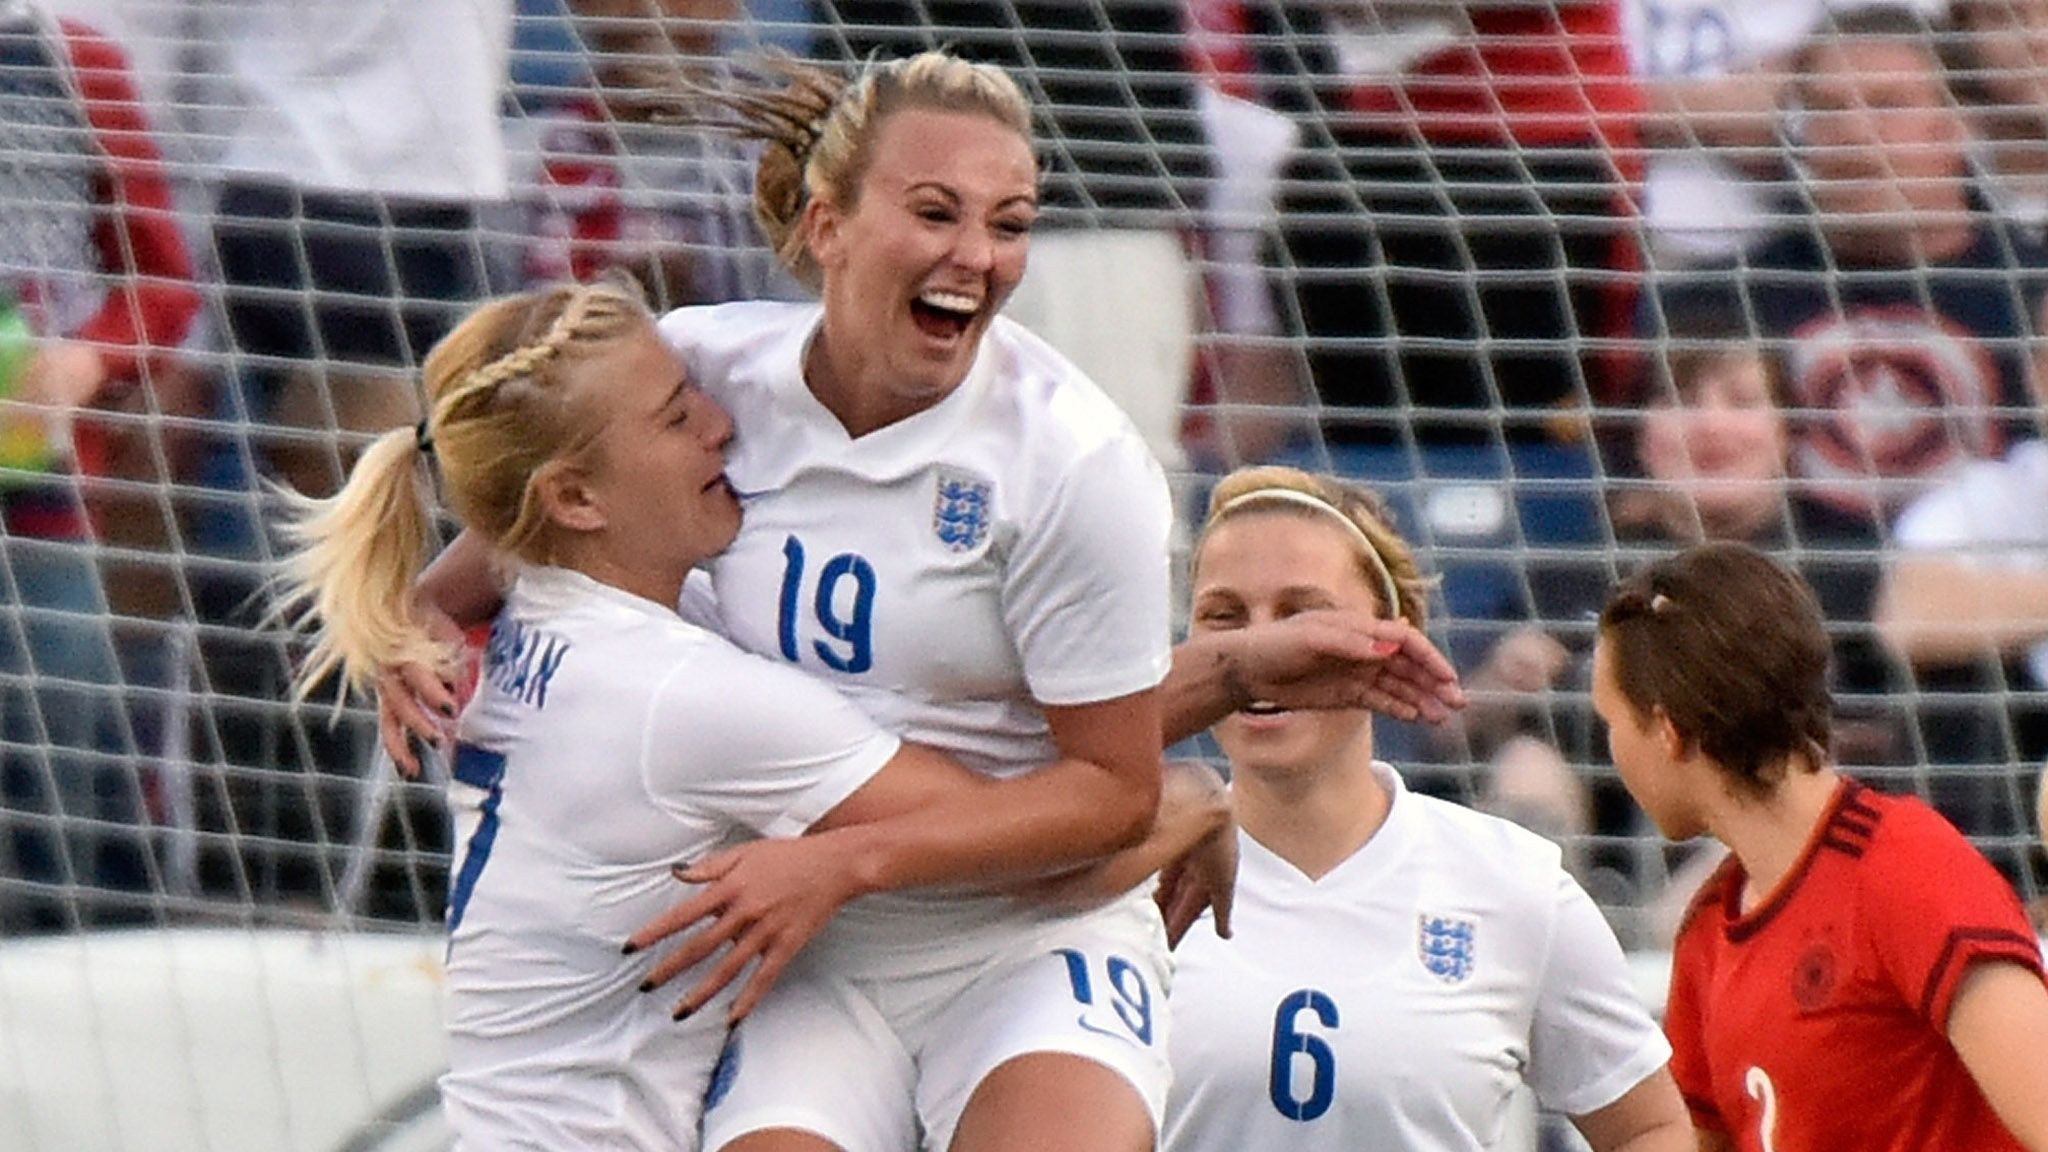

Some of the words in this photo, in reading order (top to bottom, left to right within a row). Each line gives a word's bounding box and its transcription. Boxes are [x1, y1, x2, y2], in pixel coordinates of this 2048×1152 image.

[779, 534, 877, 674] 19
[1051, 948, 1152, 1046] 19
[1269, 989, 1340, 1122] 6
